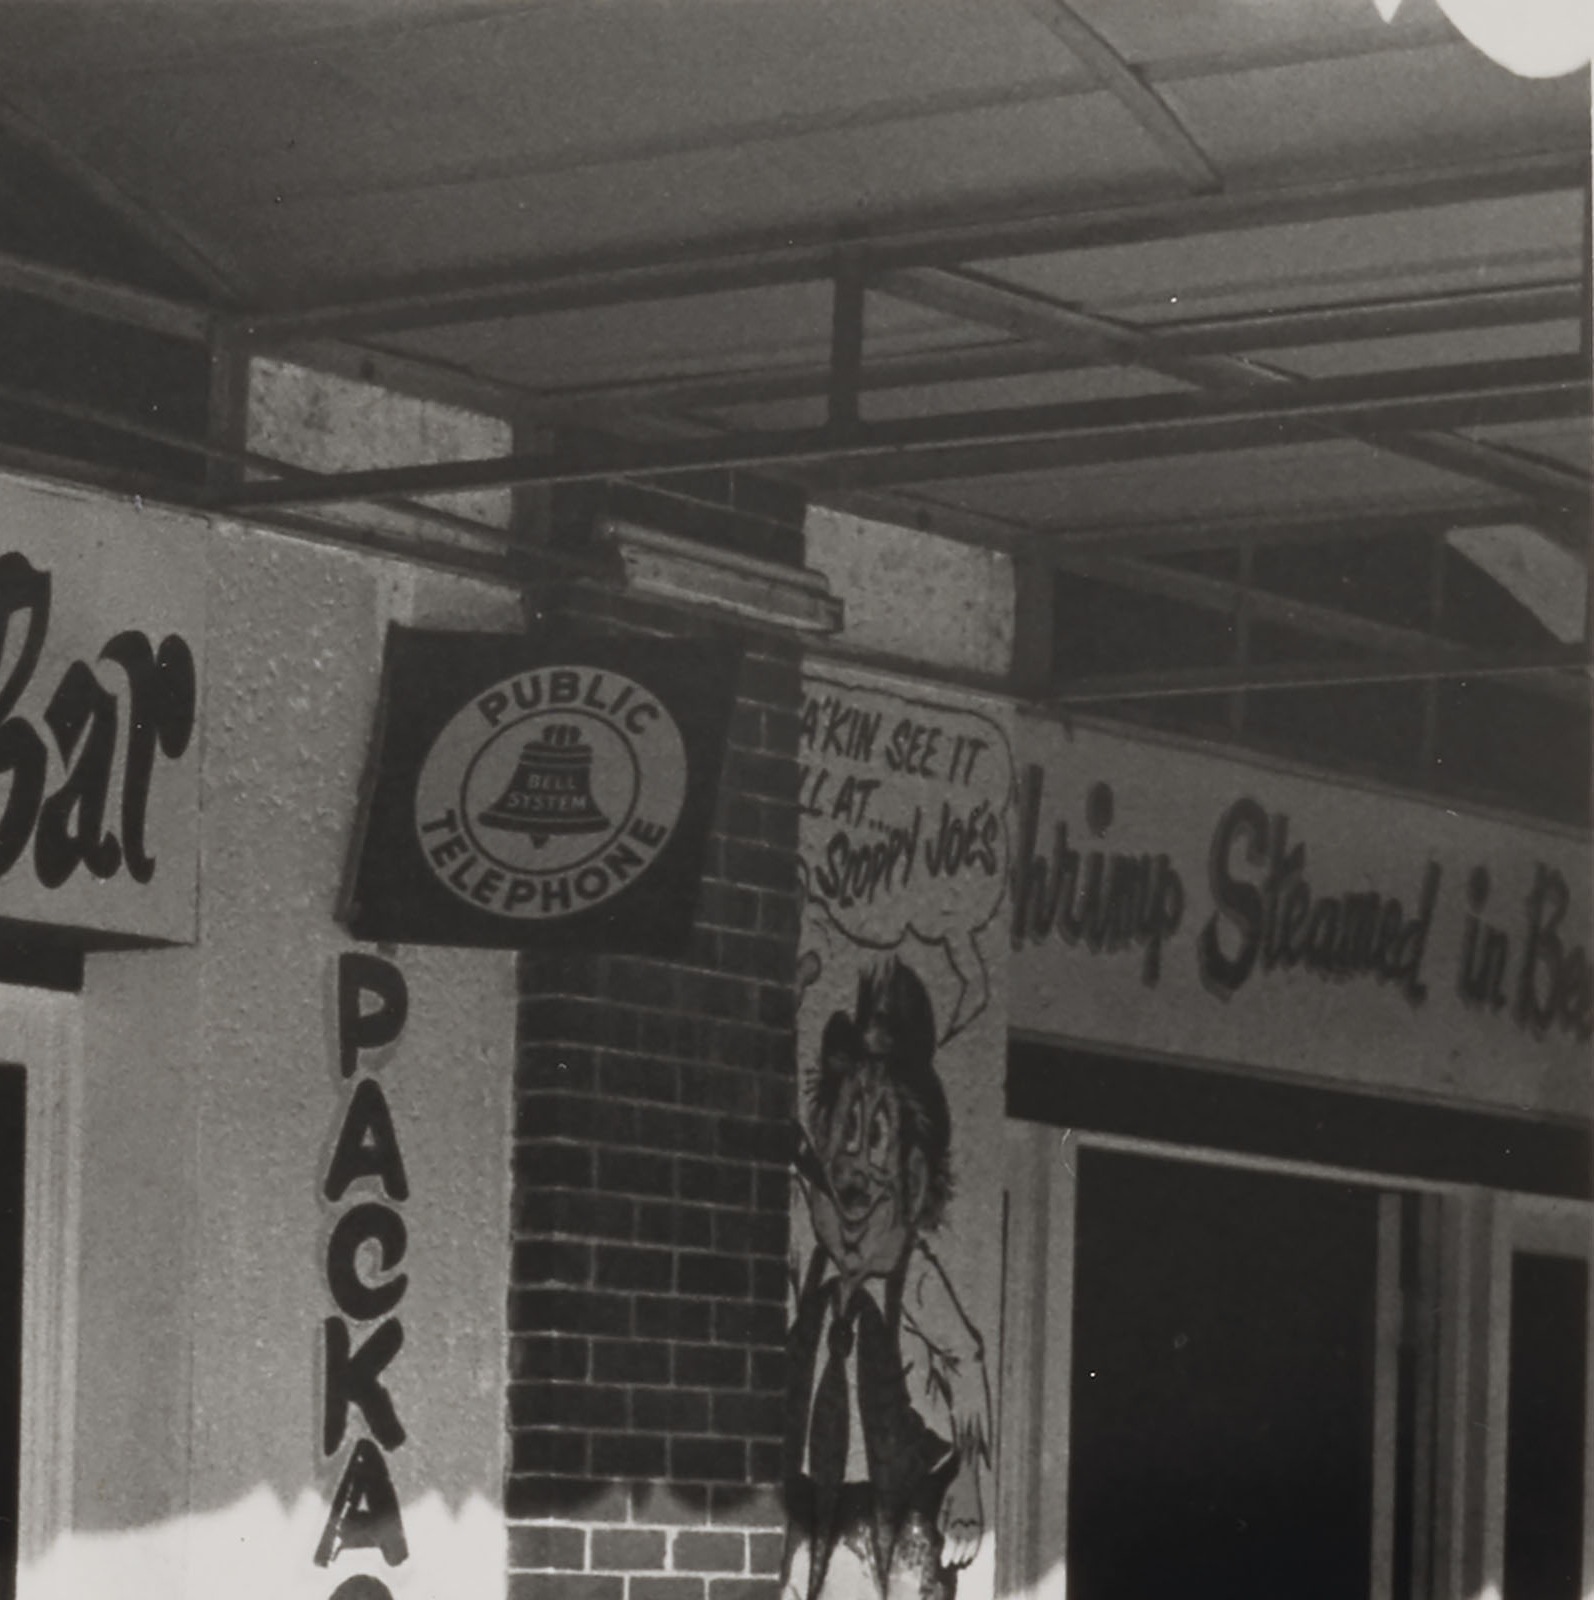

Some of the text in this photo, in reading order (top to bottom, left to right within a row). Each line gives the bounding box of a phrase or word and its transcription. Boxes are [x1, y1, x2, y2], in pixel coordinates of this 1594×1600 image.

[477, 671, 661, 735] PUBLIC
[527, 773, 577, 791] BELL
[886, 718, 943, 779] SEE
[948, 735, 989, 787] IT
[506, 791, 588, 812] SYSTEM
[421, 808, 668, 913] TELEPHONE
[1196, 797, 1443, 1009] Steamed
[1455, 864, 1509, 1016] in
